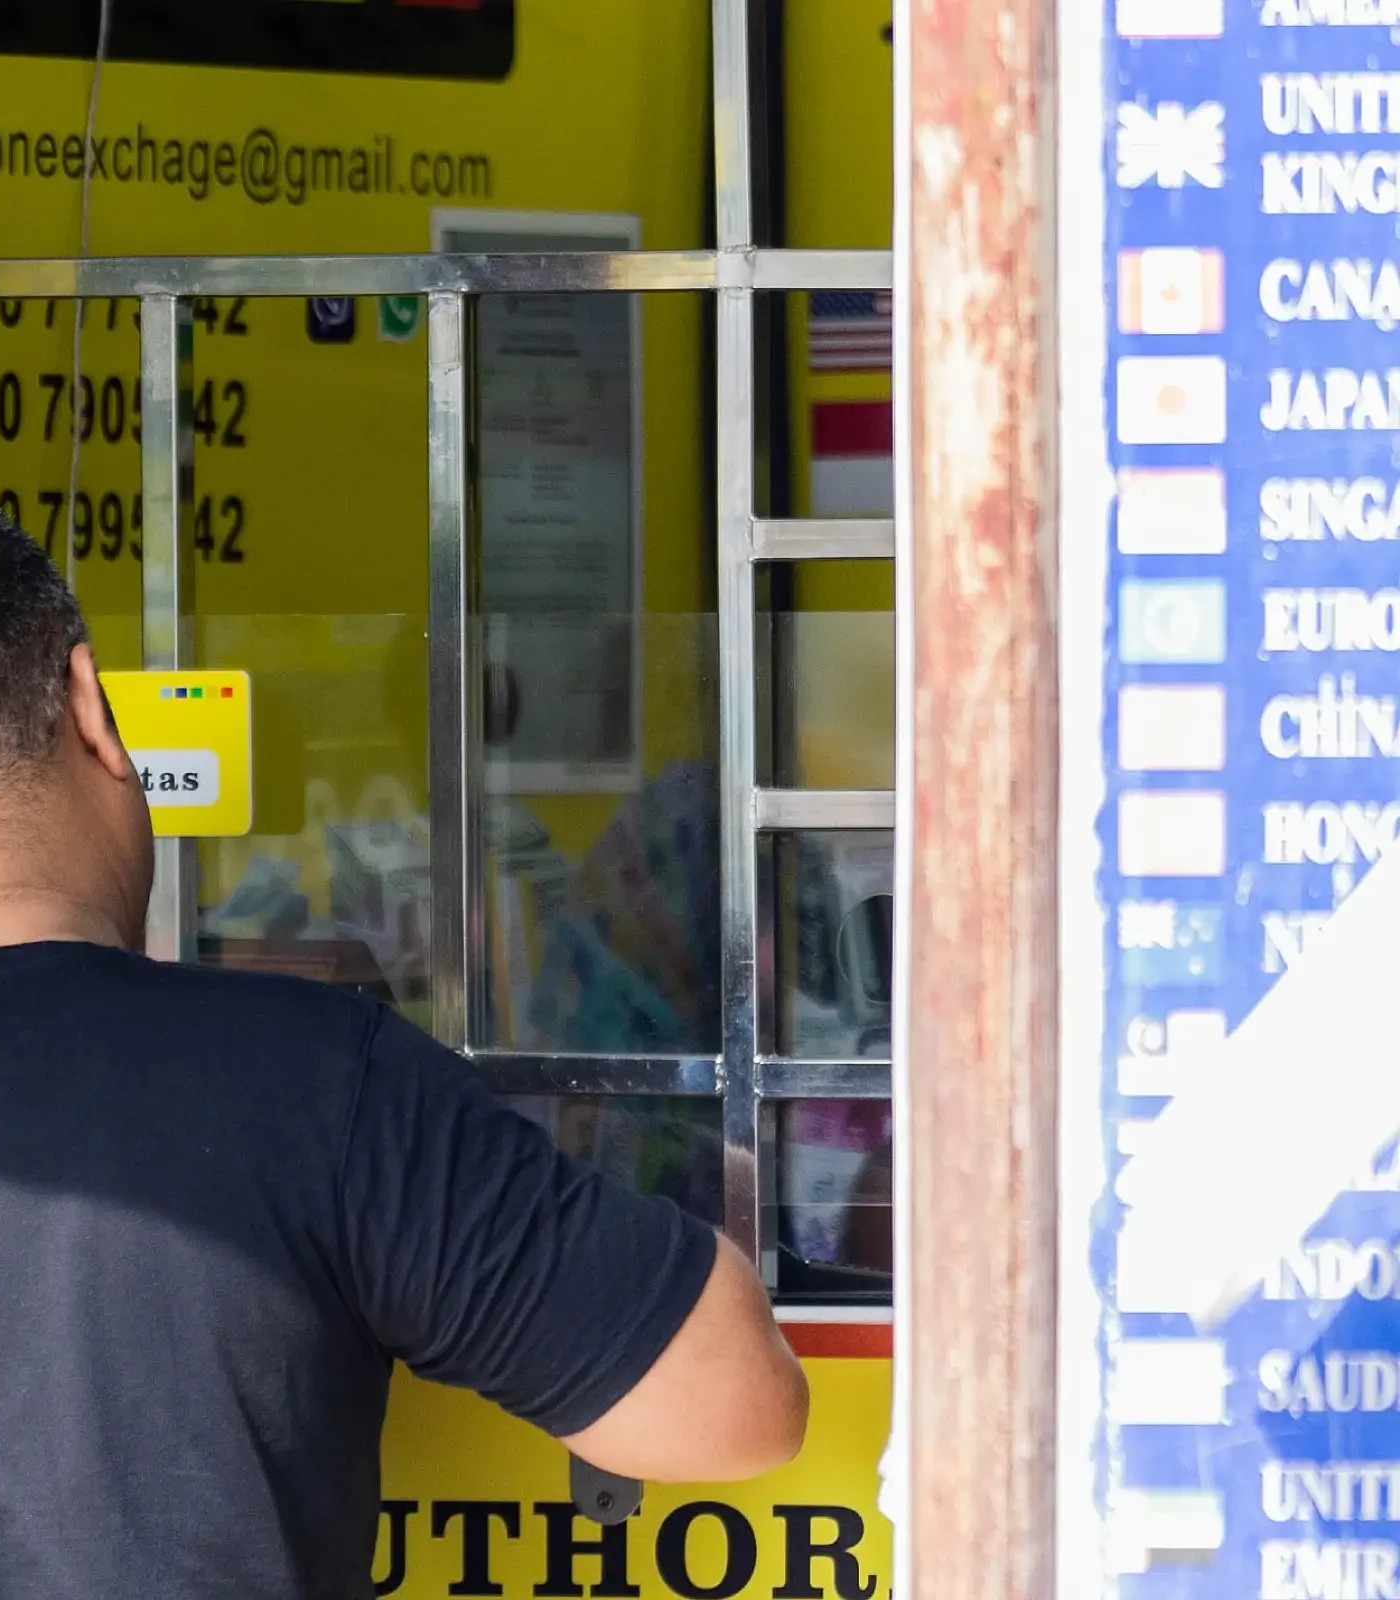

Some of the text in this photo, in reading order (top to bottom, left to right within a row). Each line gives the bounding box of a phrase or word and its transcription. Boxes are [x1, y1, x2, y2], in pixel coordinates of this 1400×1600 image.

[1260, 150, 1400, 214] KING
[1260, 692, 1400, 758] CHIN
[1257, 1350, 1400, 1412] SAUD
